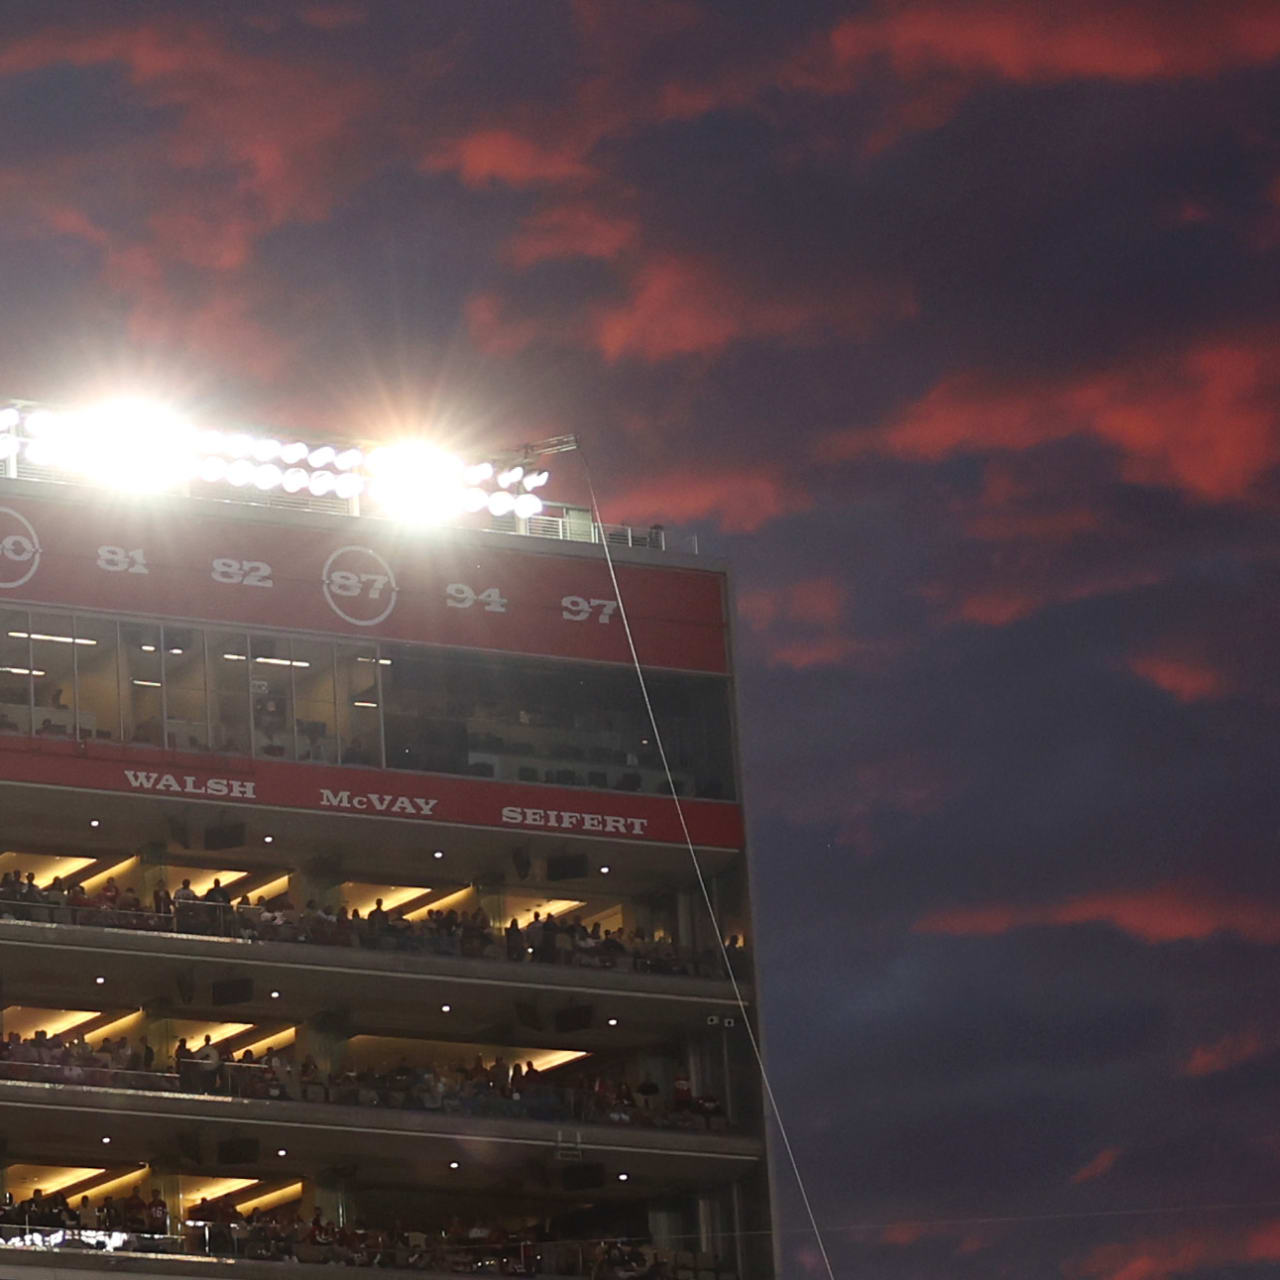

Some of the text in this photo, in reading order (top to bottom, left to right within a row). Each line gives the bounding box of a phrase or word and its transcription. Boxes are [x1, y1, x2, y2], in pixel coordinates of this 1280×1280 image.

[97, 546, 149, 574] 81
[212, 558, 273, 587] 82
[329, 571, 390, 600] 87
[445, 582, 507, 613] 94
[561, 595, 618, 625] 97
[124, 770, 256, 800] WALSH
[502, 806, 648, 836] SEIFERT
